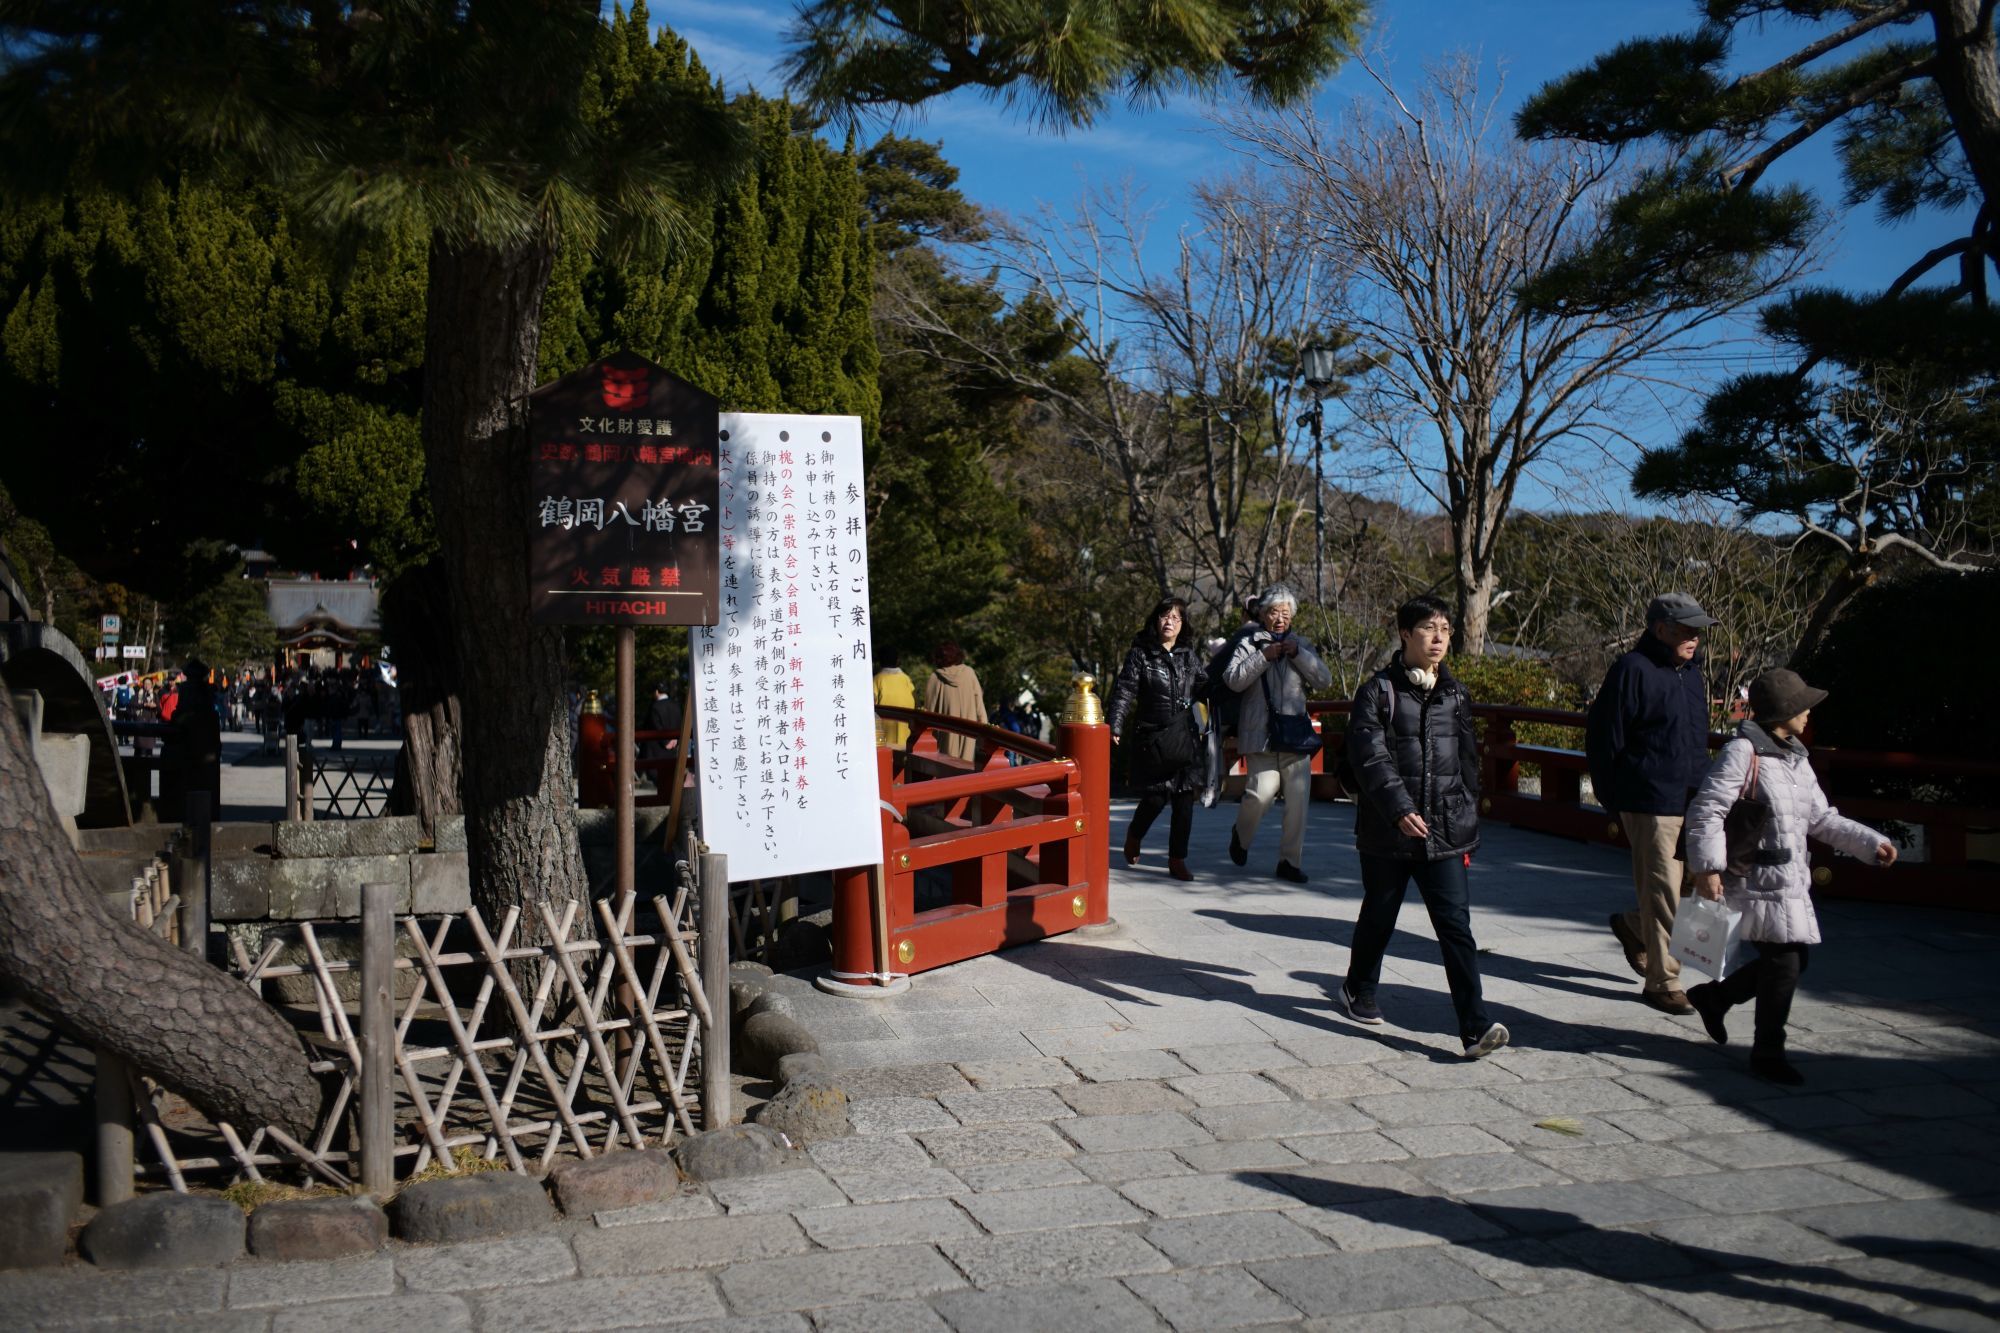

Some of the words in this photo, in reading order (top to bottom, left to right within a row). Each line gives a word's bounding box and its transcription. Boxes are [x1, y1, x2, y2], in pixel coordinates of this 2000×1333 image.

[579, 416, 673, 436] 文化財愛護
[538, 496, 711, 533] 鶴岡八幡宮
[805, 451, 825, 601] お申し込み下さい。
[571, 566, 681, 586] 火気厳禁
[845, 482, 867, 661] 参拝のご案内
[586, 601, 667, 615] HITACHI
